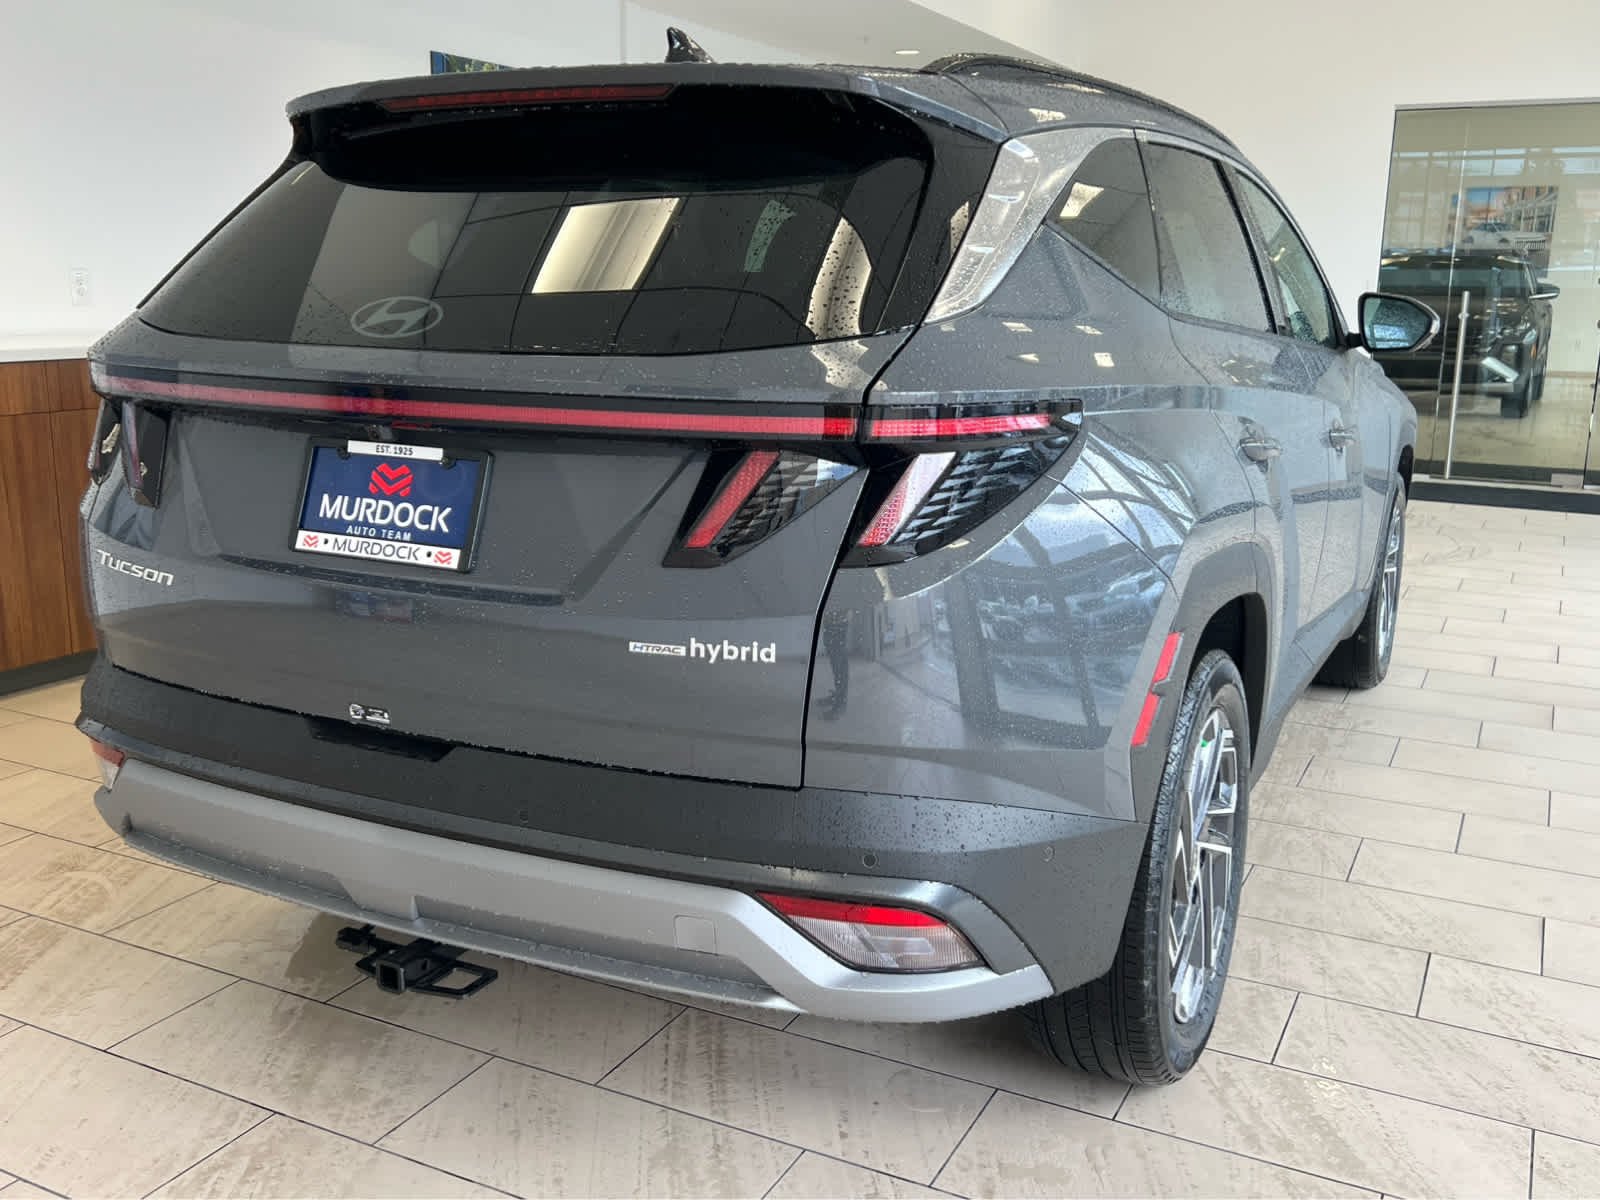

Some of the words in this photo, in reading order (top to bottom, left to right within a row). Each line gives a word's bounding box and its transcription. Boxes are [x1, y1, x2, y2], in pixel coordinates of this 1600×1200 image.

[393, 446, 414, 456] 1925
[319, 493, 452, 533] MURDOCK
[346, 525, 375, 537] AUTO
[382, 529, 412, 541] TEAM
[332, 537, 421, 561] MURDOCK
[97, 549, 174, 586] Tucson
[690, 637, 776, 664] hybrid
